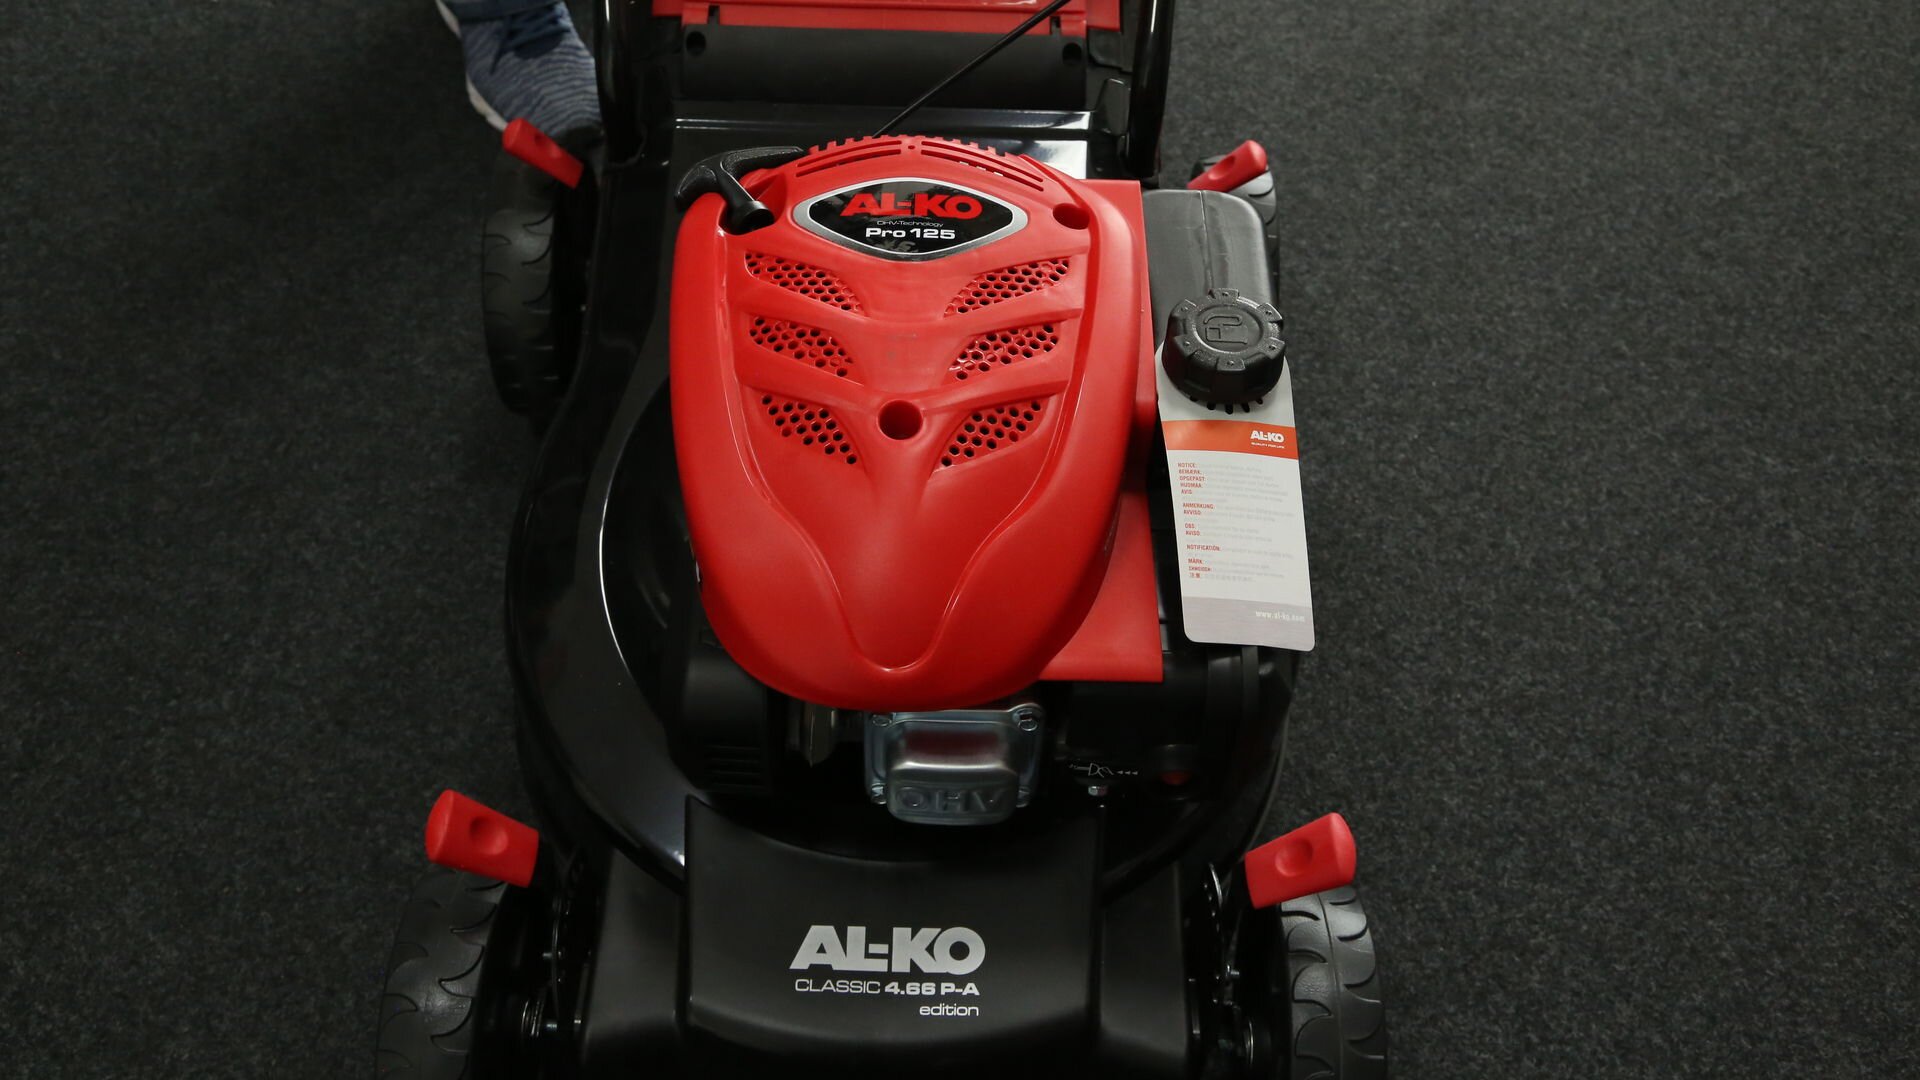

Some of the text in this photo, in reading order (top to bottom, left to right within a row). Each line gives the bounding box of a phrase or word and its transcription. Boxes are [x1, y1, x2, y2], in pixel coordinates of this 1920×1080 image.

[840, 193, 983, 220] AL-KO
[876, 220, 944, 228] OHV-Technology
[865, 227, 956, 239] Pro 125
[1250, 430, 1285, 443] AL-KO
[897, 786, 1007, 813] OHV
[789, 925, 986, 975] AL-KO
[795, 978, 980, 996] CLASSIC 4.66 P-A
[919, 1003, 979, 1016] edition
